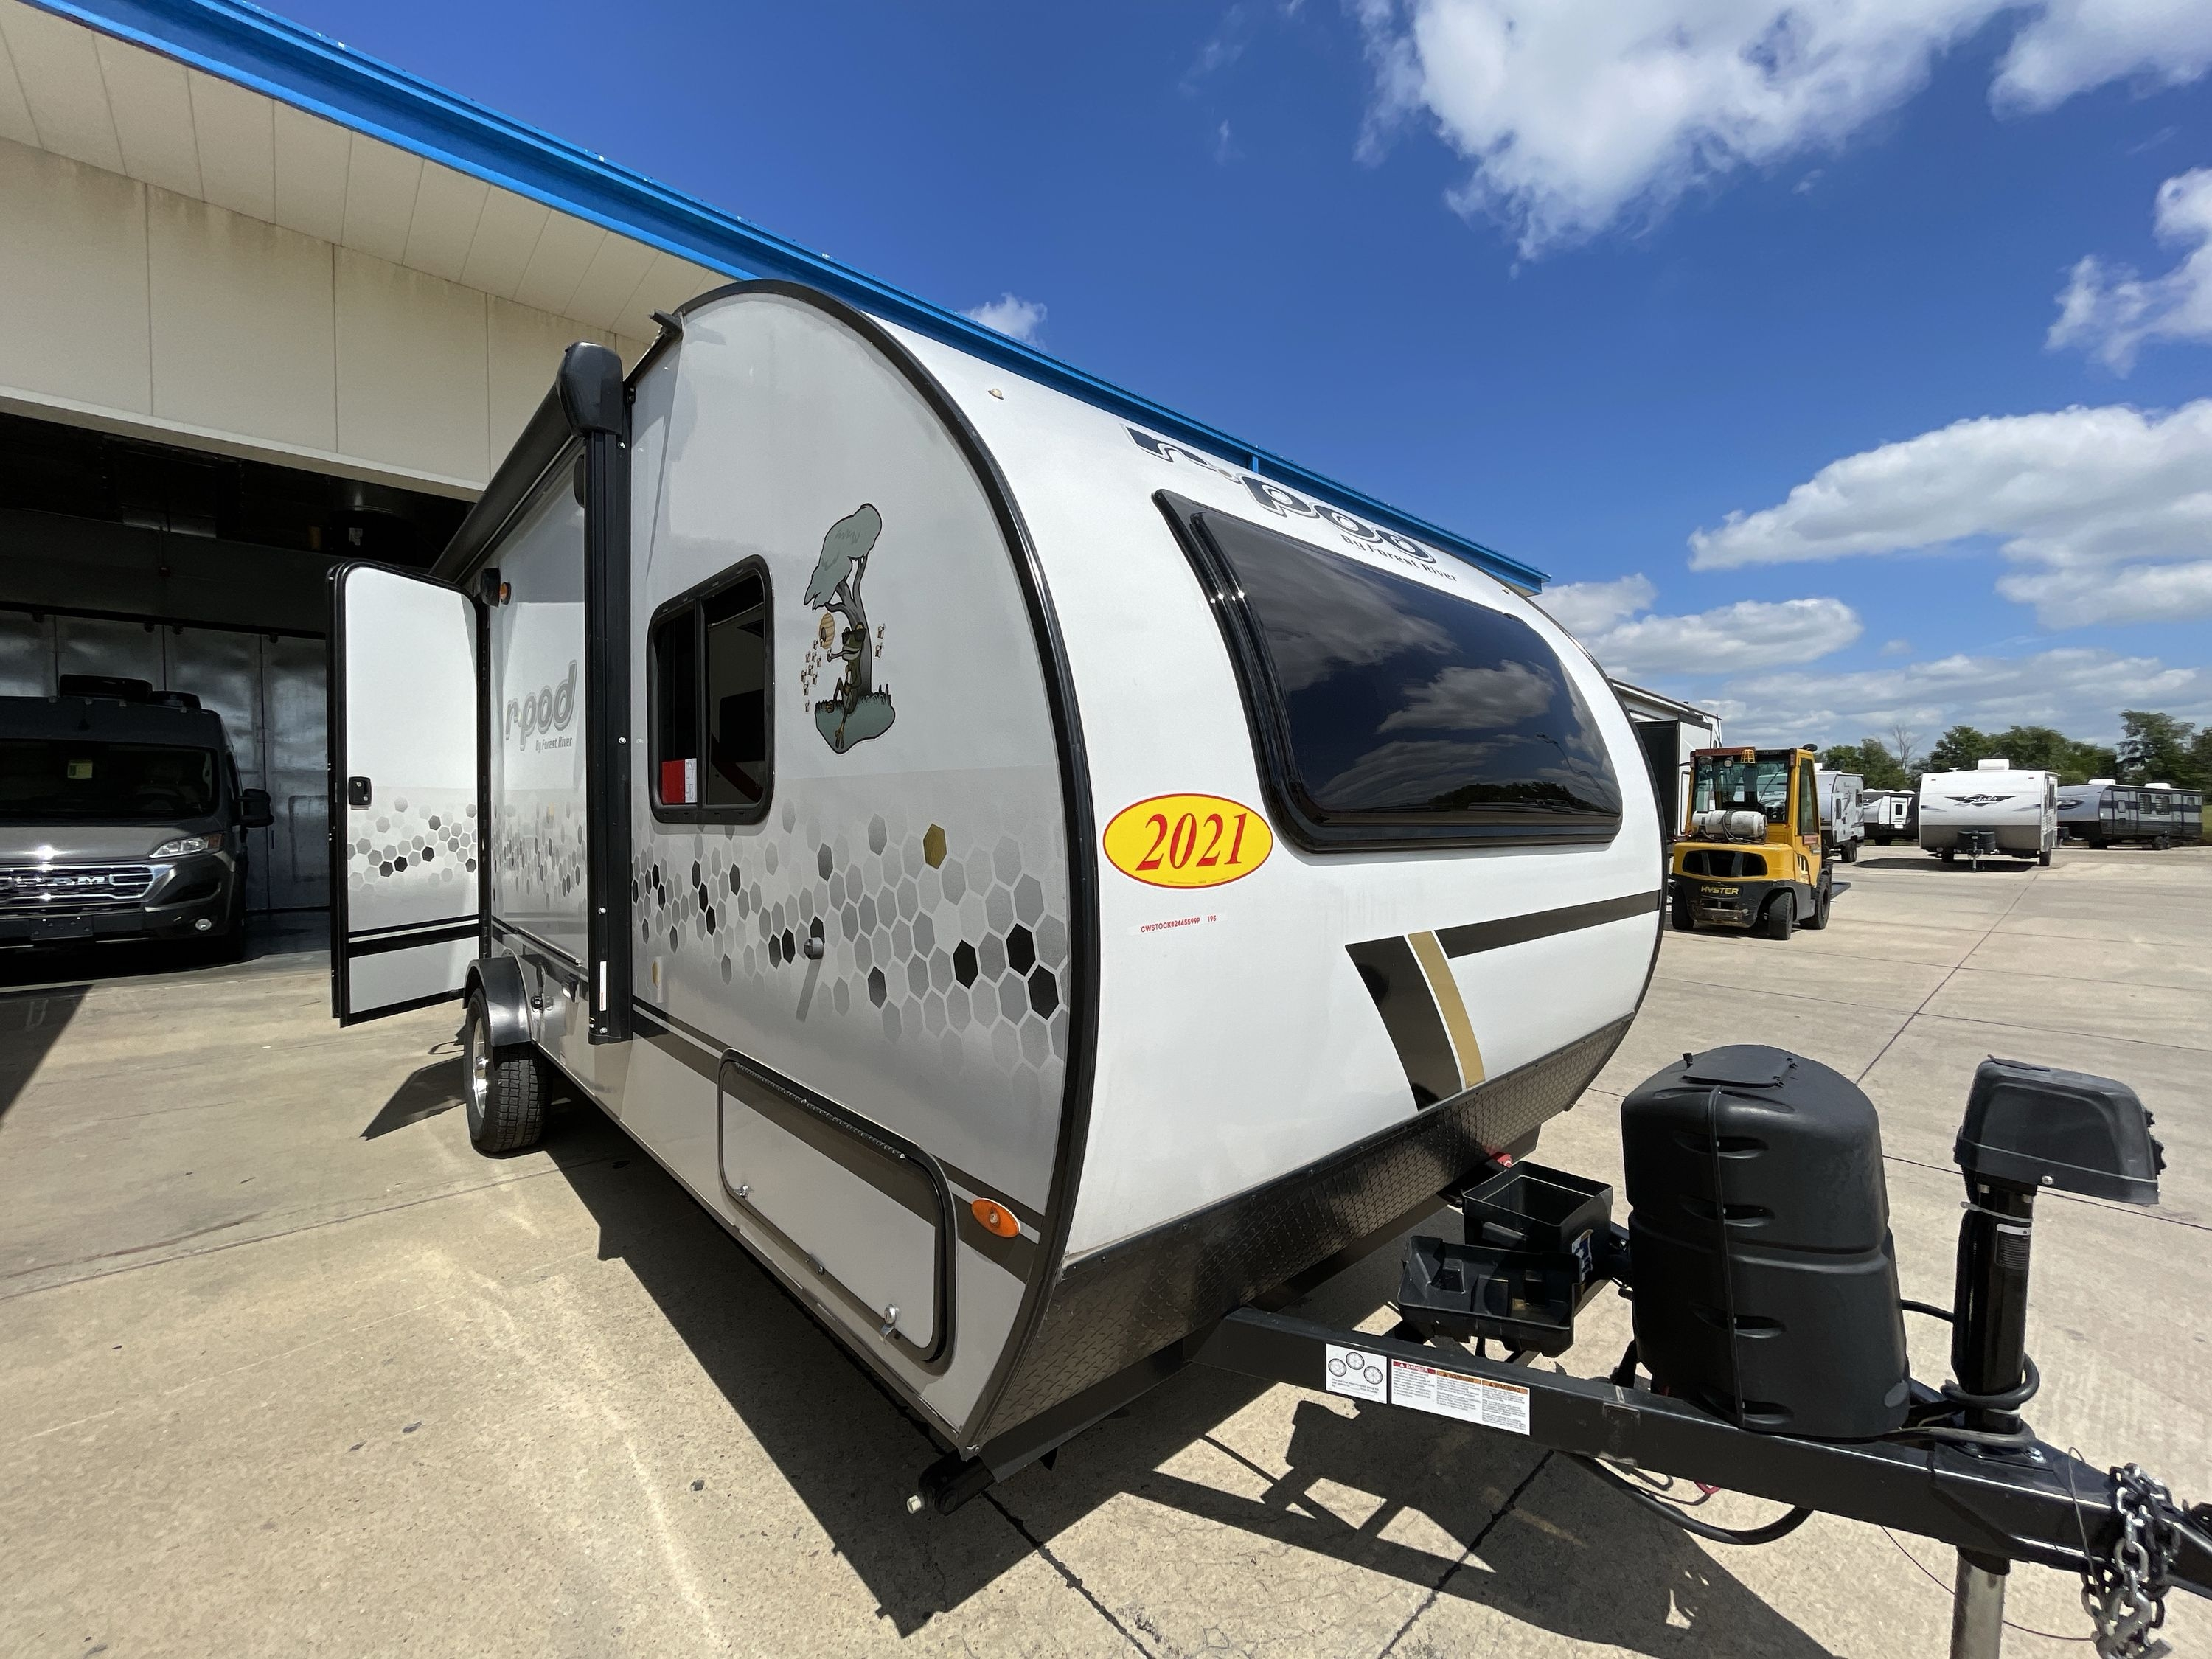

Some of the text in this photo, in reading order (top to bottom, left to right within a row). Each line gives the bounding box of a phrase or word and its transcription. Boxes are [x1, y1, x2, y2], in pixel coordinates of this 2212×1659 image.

[1340, 534, 1458, 582] By Forest River
[542, 739, 557, 750] Forest
[558, 736, 573, 748] River
[1135, 813, 1248, 871] 2021
[1700, 886, 1739, 894] HYSTER
[1405, 1364, 1428, 1373] DANGER
[1449, 1373, 1475, 1383] WARNING
[1495, 1383, 1521, 1393] WARNING
